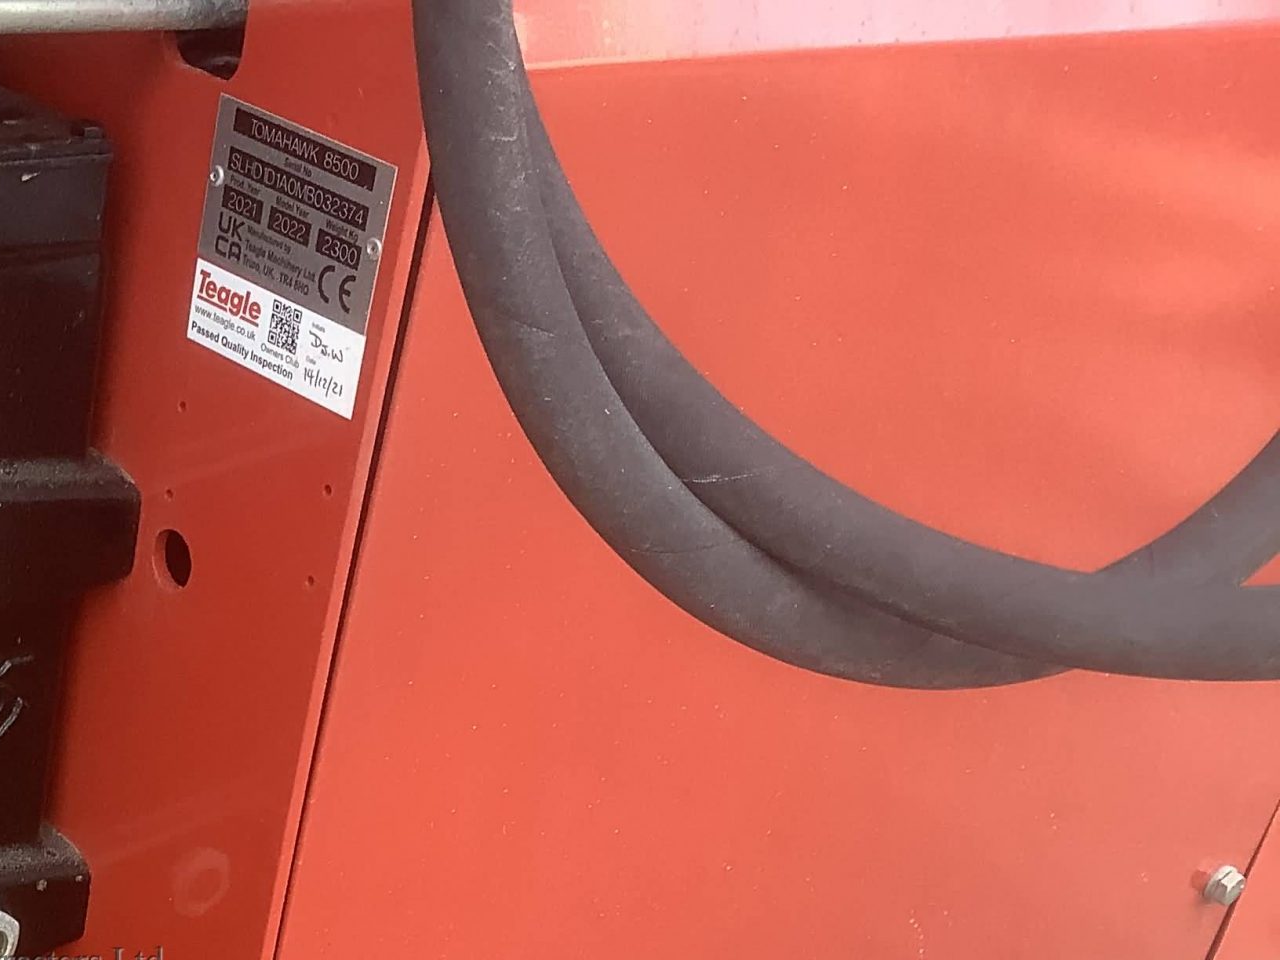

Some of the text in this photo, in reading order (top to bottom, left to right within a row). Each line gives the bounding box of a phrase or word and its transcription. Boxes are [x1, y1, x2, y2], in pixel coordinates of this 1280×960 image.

[250, 118, 359, 182] TOMAHAWK 8500
[227, 191, 257, 218] 2021
[218, 211, 246, 241] UK
[272, 213, 306, 242] 2022
[323, 235, 358, 265] 2300
[199, 269, 262, 321] Teagle
[194, 305, 257, 342] www.teagle.co.uk
[191, 321, 294, 381] Passed Quality Inspection
[260, 343, 300, 369] Owners Club
[304, 367, 343, 398] 14/12/21
